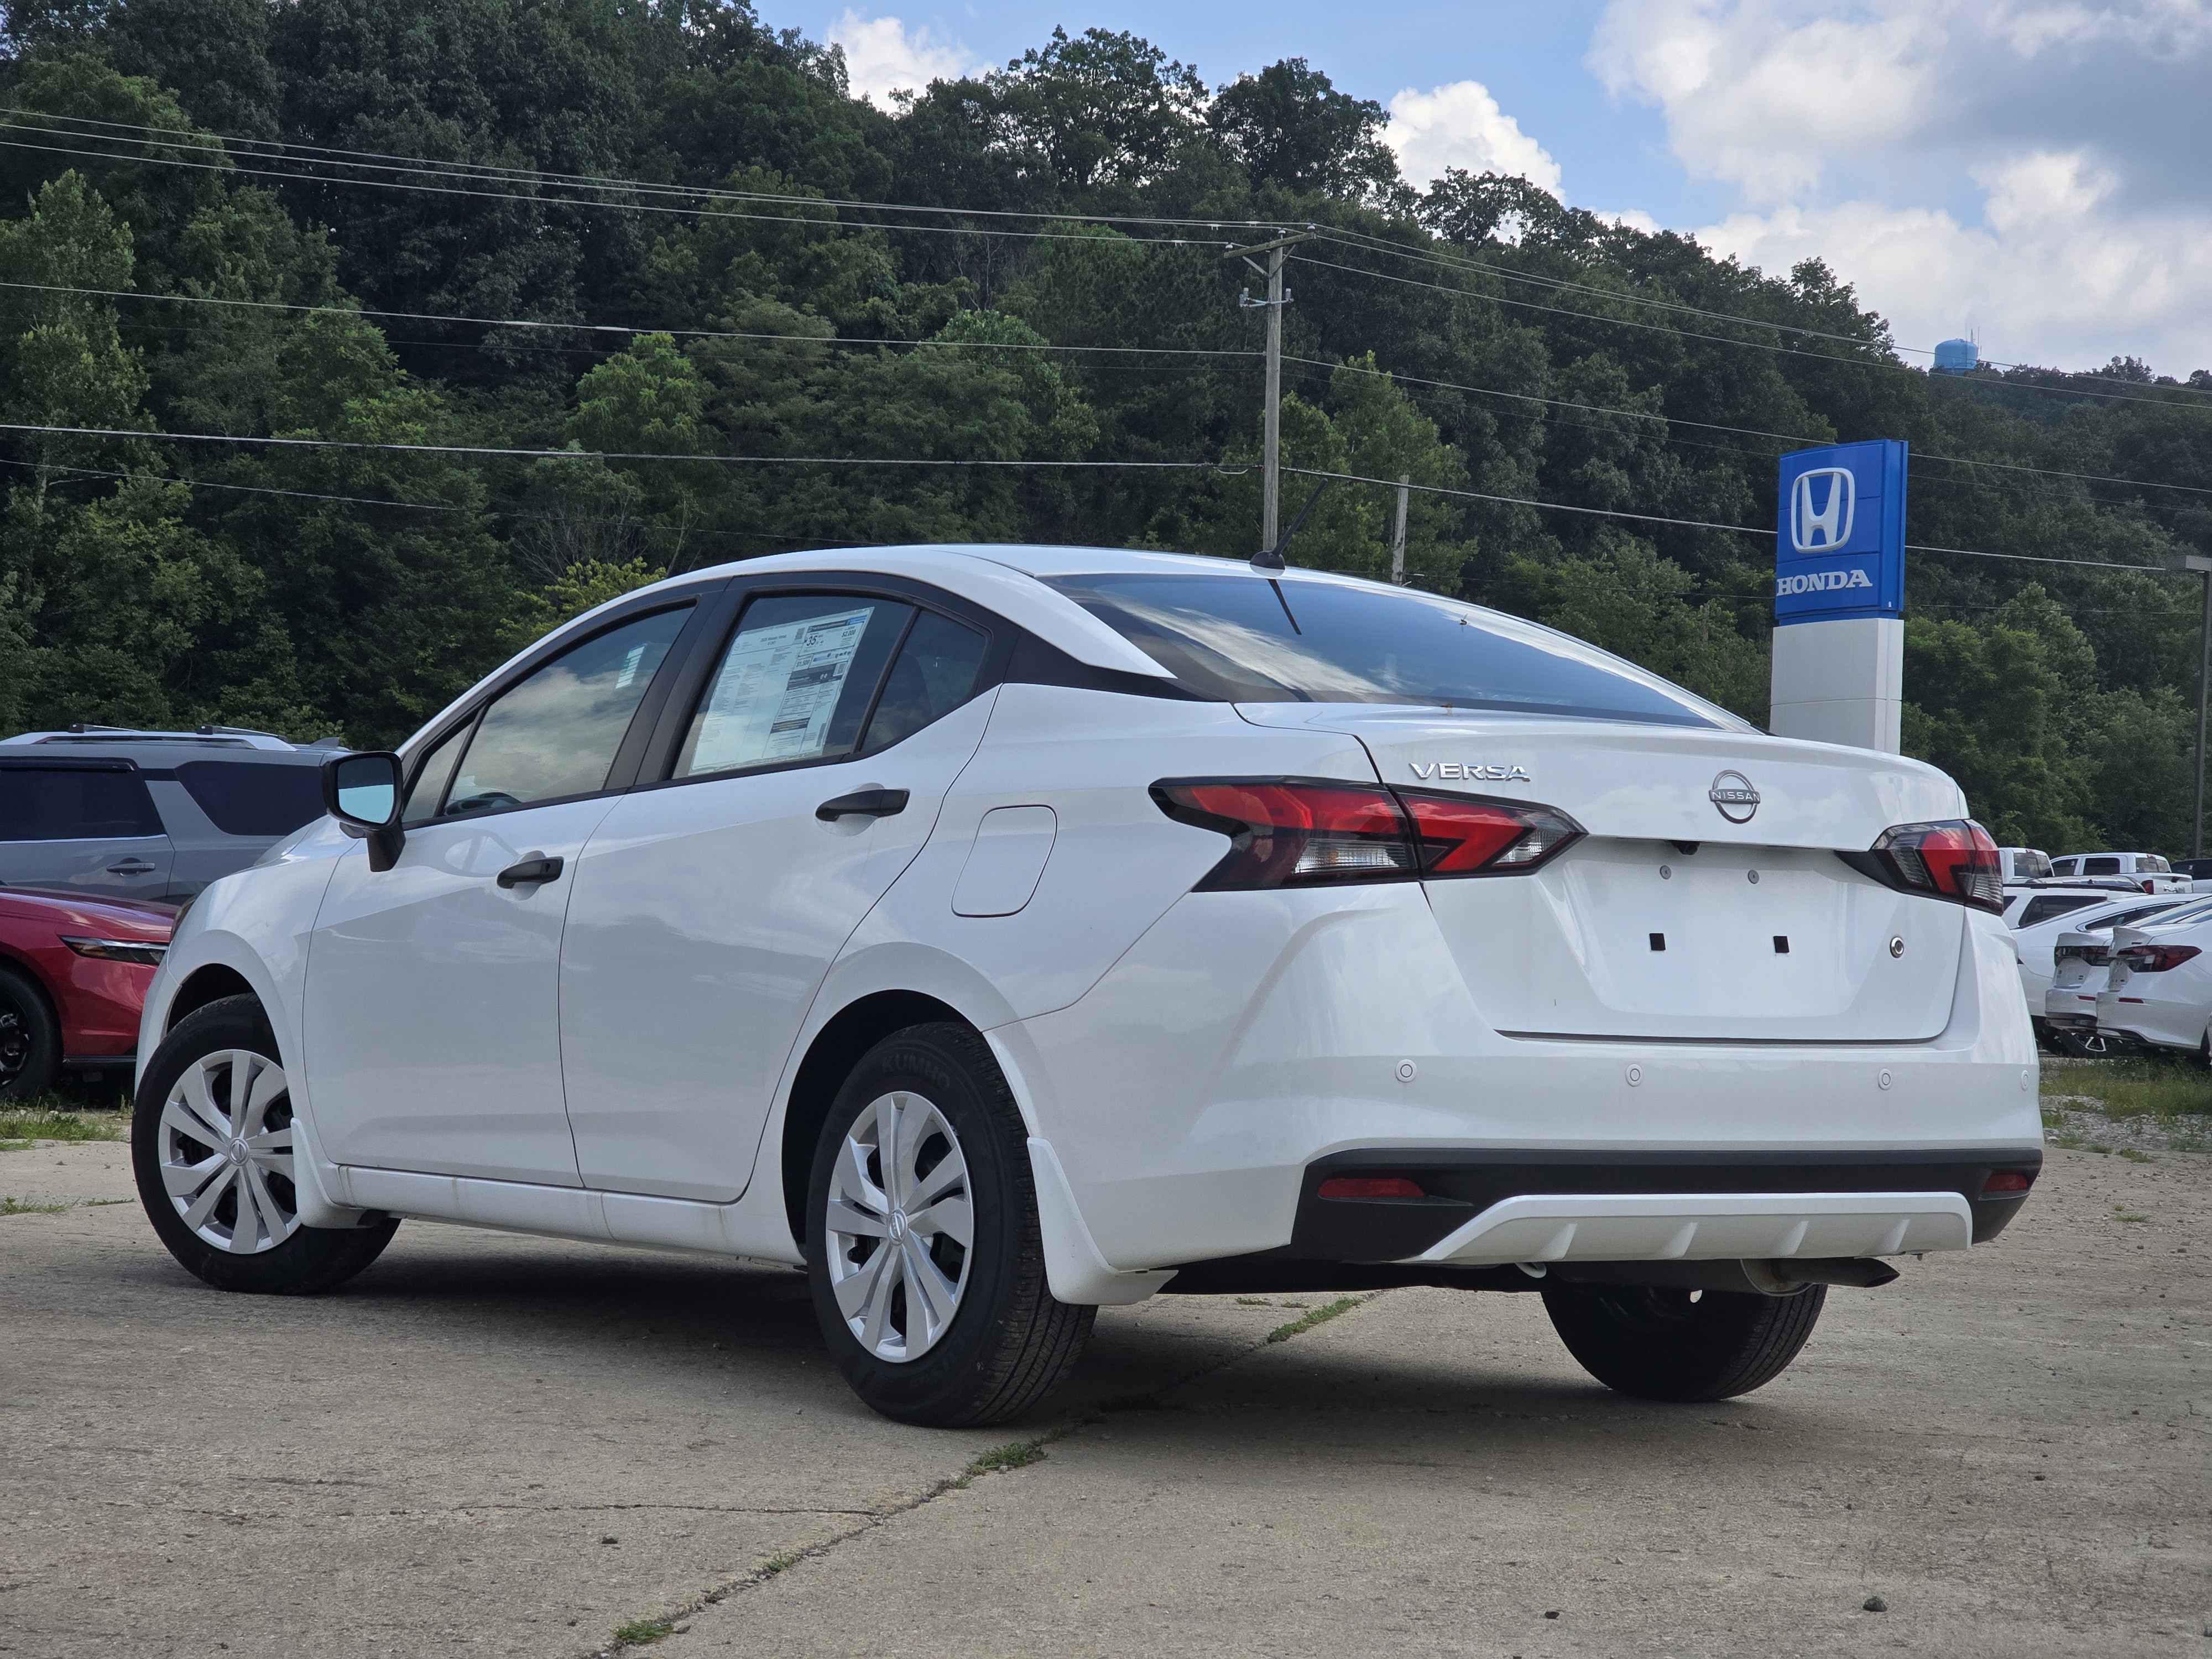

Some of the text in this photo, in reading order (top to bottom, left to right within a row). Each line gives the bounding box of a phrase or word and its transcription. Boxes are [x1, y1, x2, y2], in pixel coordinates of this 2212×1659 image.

[1776, 570, 1872, 597] HONDA
[806, 635, 818, 646] 35
[1408, 762, 1531, 782] VERSA
[1712, 791, 1760, 801] NISSAN
[882, 1053, 950, 1092] KUMHO
